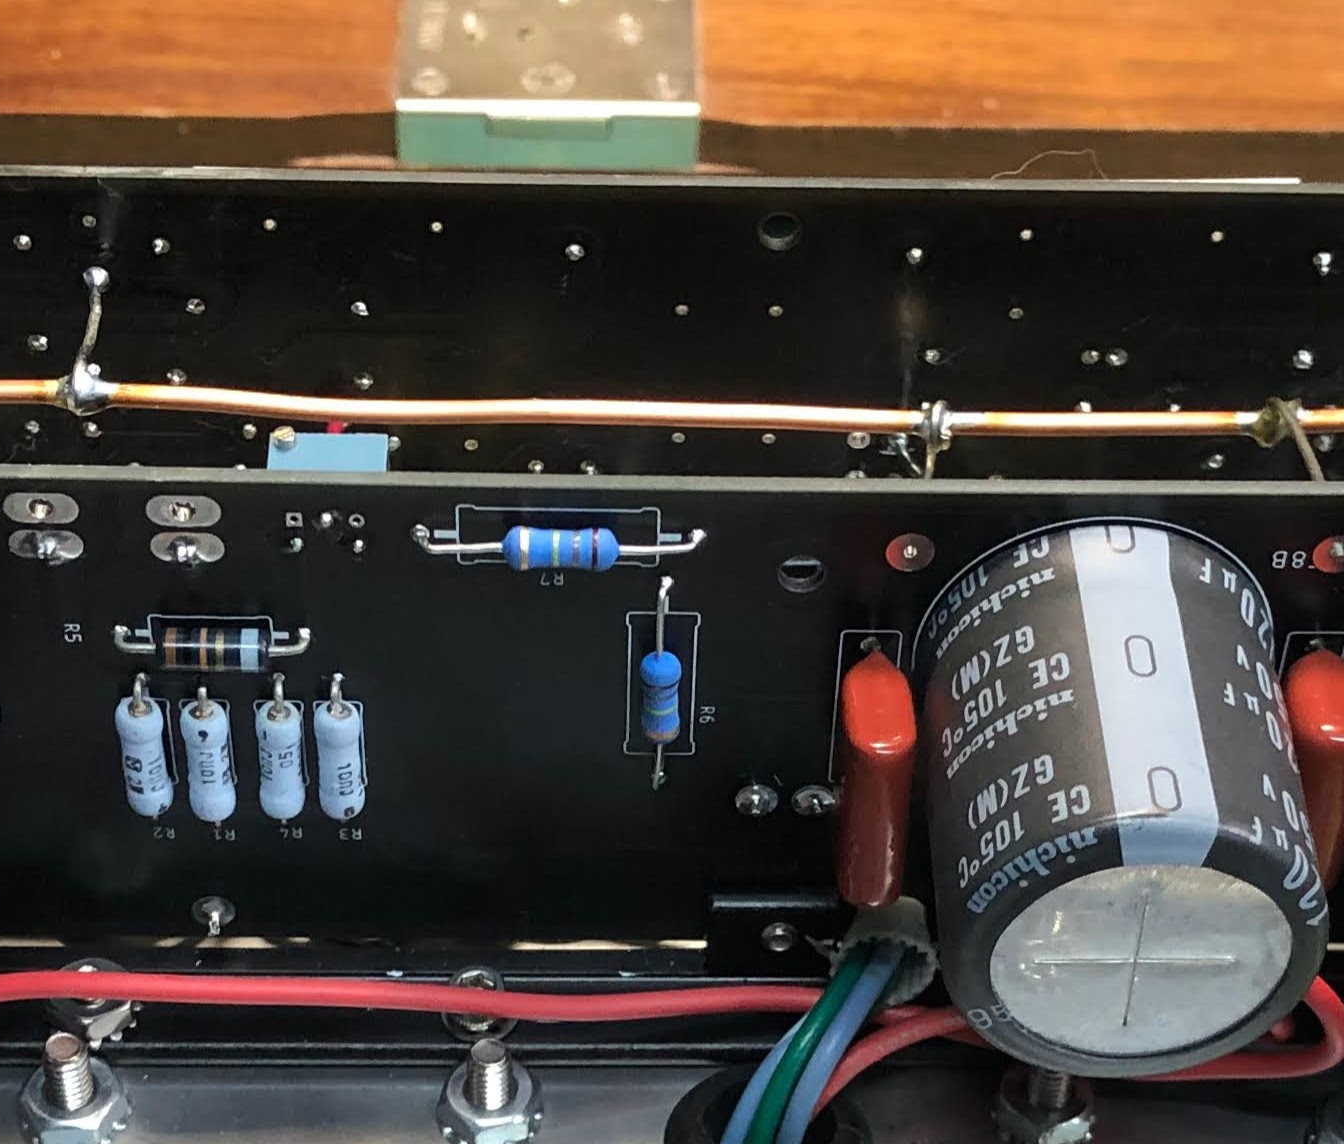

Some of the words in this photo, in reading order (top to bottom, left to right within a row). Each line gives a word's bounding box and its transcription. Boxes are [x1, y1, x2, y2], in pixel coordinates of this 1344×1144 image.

[1272, 550, 1315, 568] 8B
[539, 570, 565, 587] R7
[936, 566, 1056, 659] nichicon
[64, 622, 82, 645] R5
[951, 625, 1035, 701] GZ(M)
[1028, 652, 1069, 689] CE
[698, 704, 716, 724] R6
[946, 689, 1074, 780] nichicon
[966, 754, 1054, 830] GZ(M)
[1047, 785, 1091, 823] CE
[152, 826, 176, 839] R2
[212, 828, 236, 841] R1
[279, 827, 302, 839] R4
[338, 828, 362, 841] R3
[966, 826, 1099, 915] nichicon
